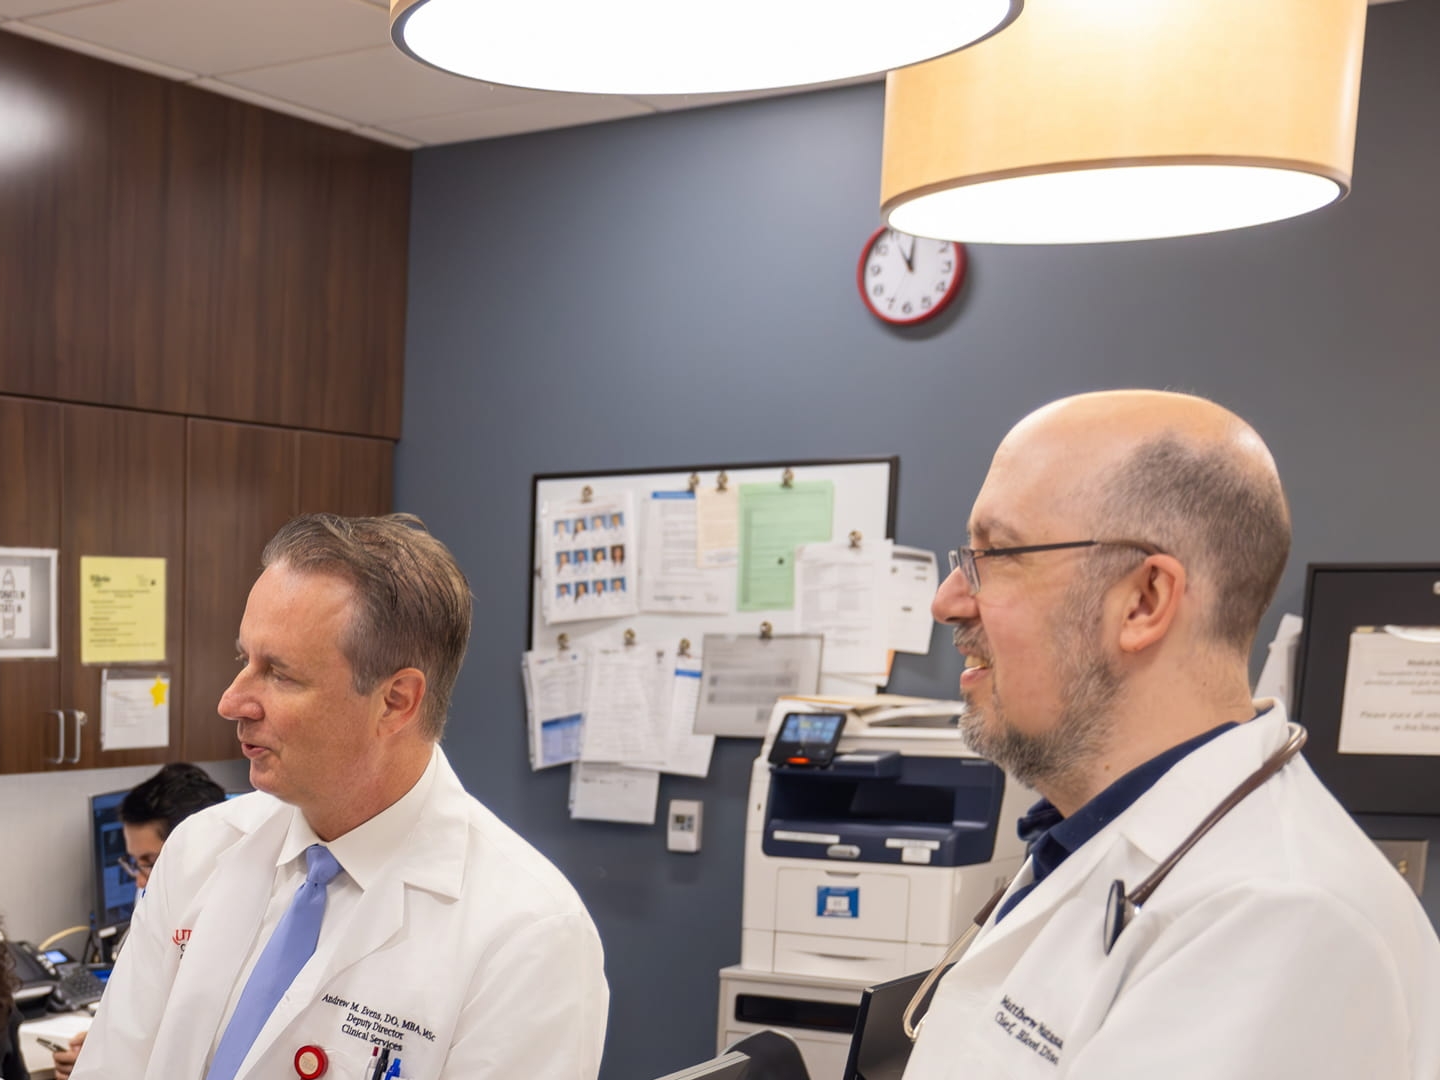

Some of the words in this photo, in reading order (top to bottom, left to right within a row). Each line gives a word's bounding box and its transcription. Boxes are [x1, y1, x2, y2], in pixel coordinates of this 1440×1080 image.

[322, 993, 349, 1008] Andrew
[349, 1002, 360, 1012] M.
[360, 1006, 383, 1021] Evens,
[384, 1013, 400, 1027] DO,
[401, 1019, 421, 1035] MBA,
[346, 1013, 372, 1031] Deputy
[341, 1023, 369, 1040] Clinical
[369, 1034, 403, 1052] Services
